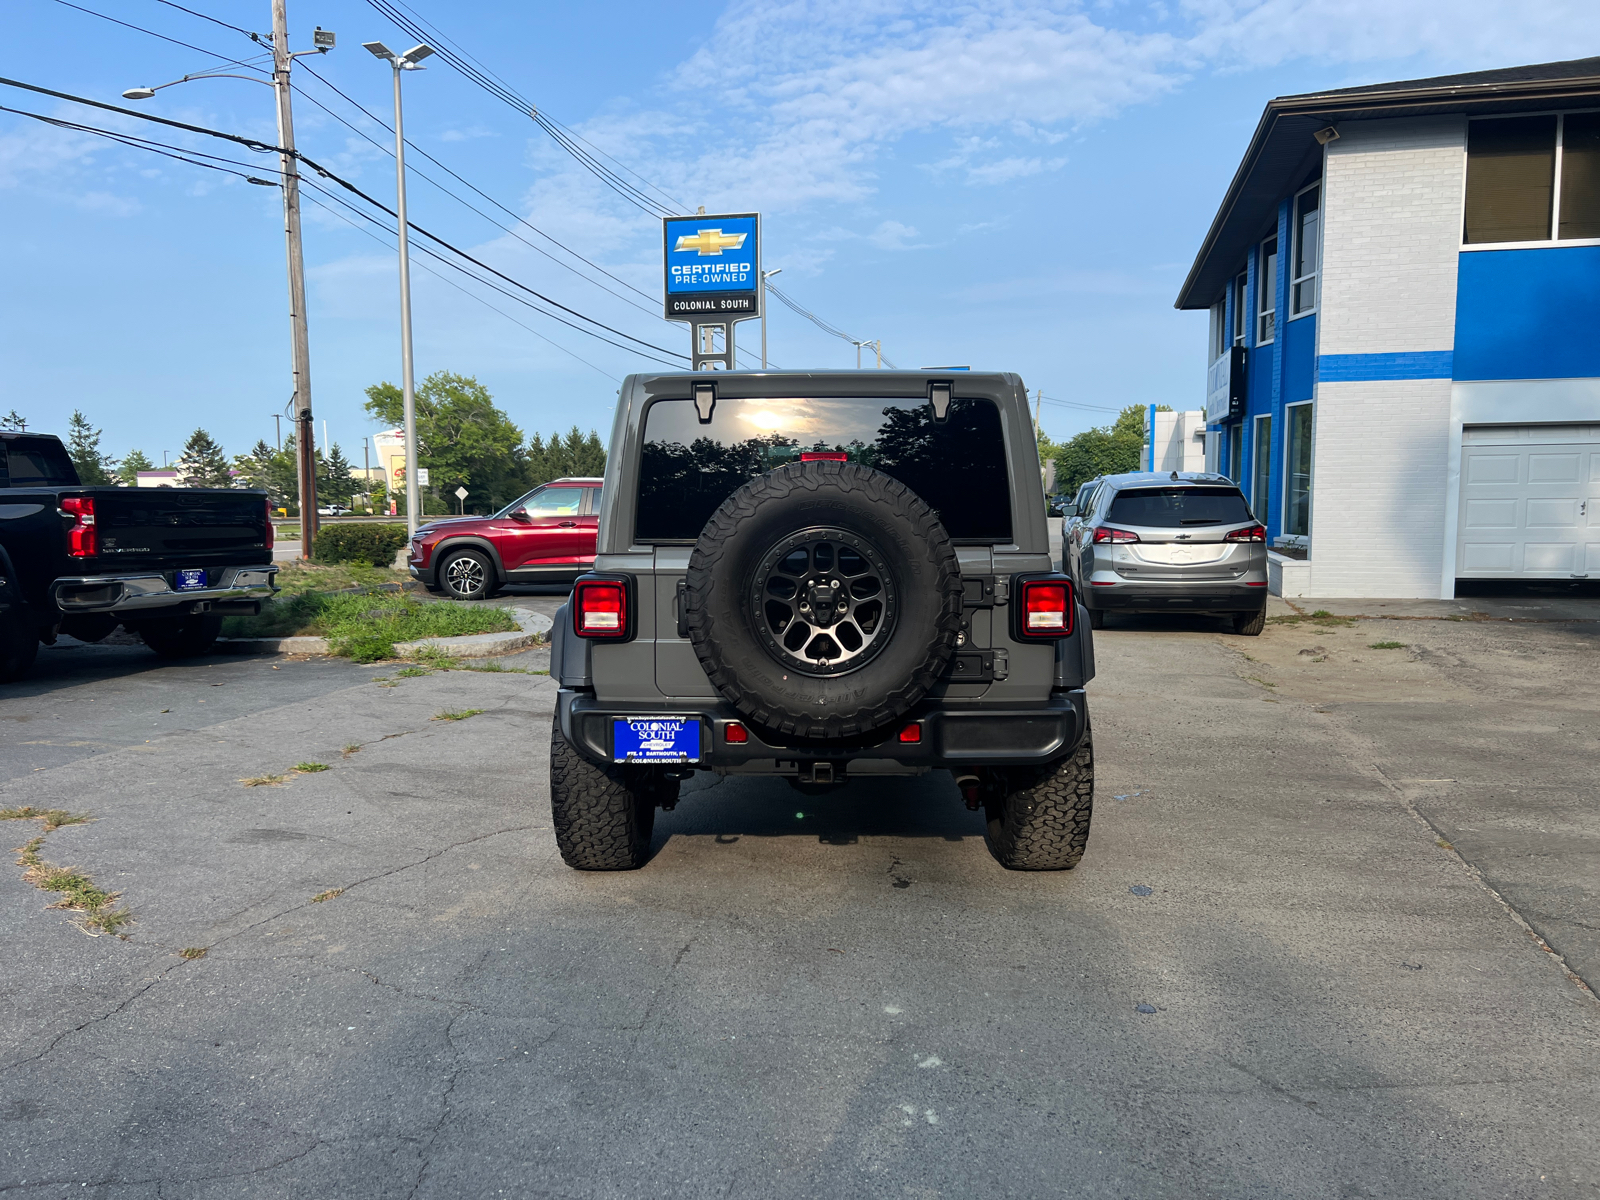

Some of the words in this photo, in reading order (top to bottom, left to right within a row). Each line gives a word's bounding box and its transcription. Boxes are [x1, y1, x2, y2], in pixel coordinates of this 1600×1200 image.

[671, 262, 751, 275] CERTIFIED
[675, 273, 747, 284] PRE-OWNED
[674, 301, 716, 311] COLONIAL
[720, 299, 749, 309] SOUTH
[798, 498, 922, 576] BFGoodrich
[630, 722, 683, 731] COLONIAL
[638, 731, 675, 740] SOUTH
